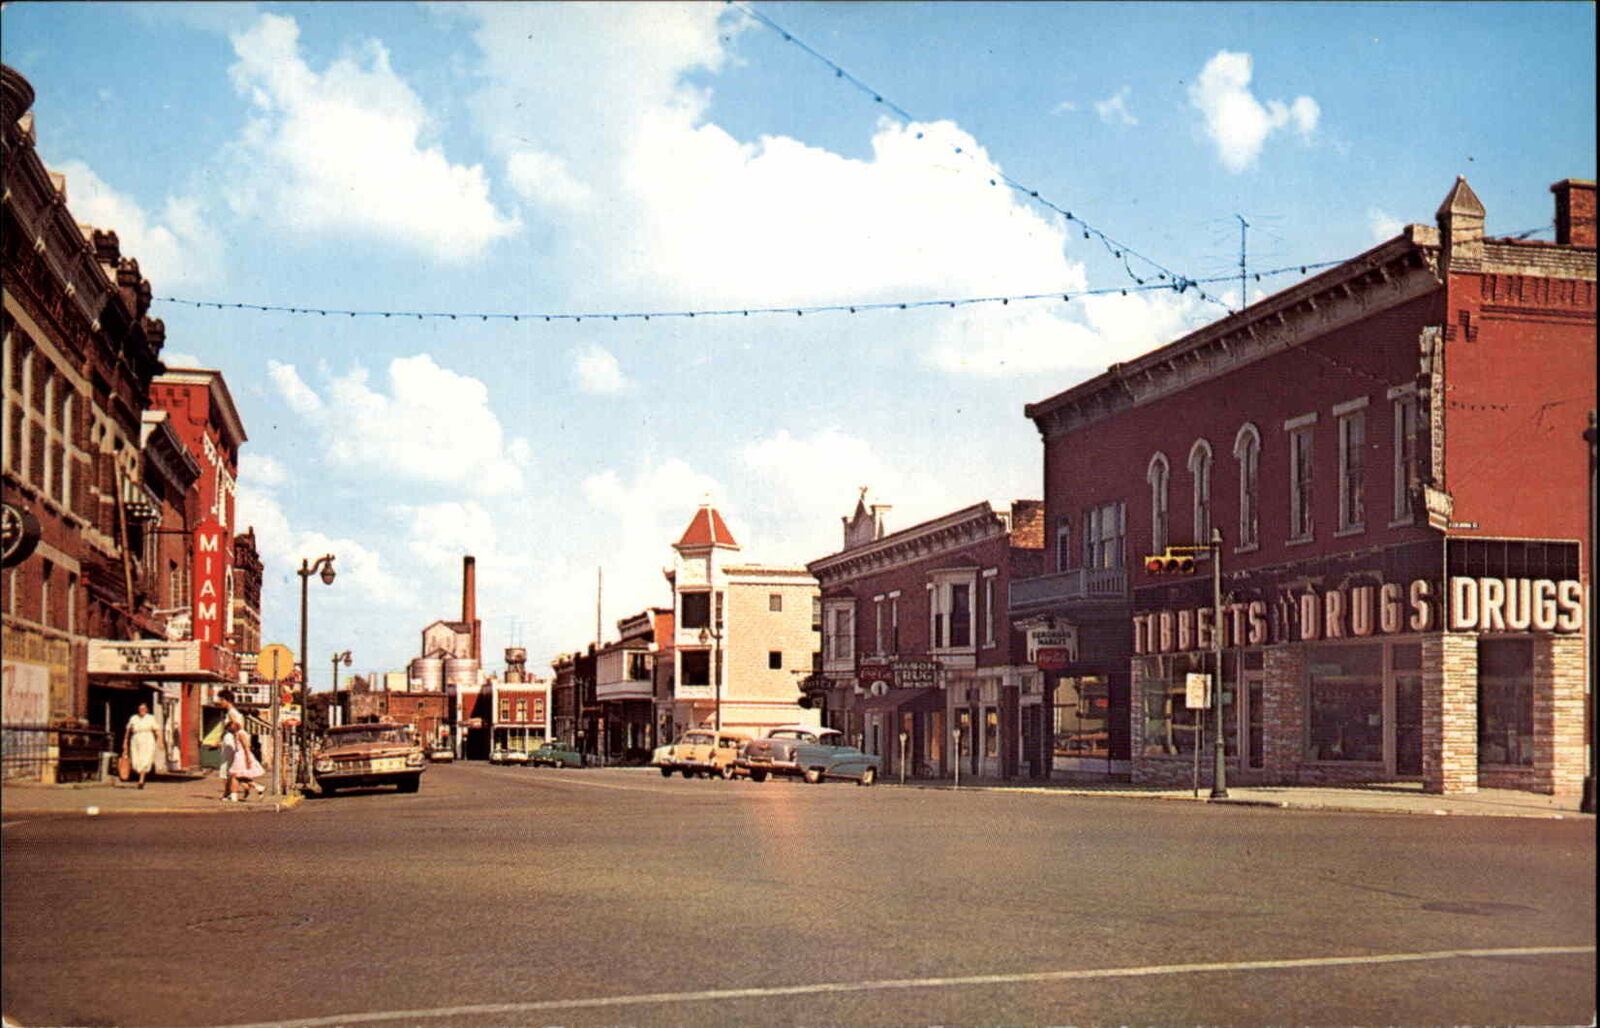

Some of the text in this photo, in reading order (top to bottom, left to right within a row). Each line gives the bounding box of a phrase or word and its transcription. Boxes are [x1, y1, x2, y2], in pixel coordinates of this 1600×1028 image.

[199, 534, 218, 641] MIAMI
[1301, 580, 1431, 640] DRUGS
[1451, 576, 1583, 631] DRUGS
